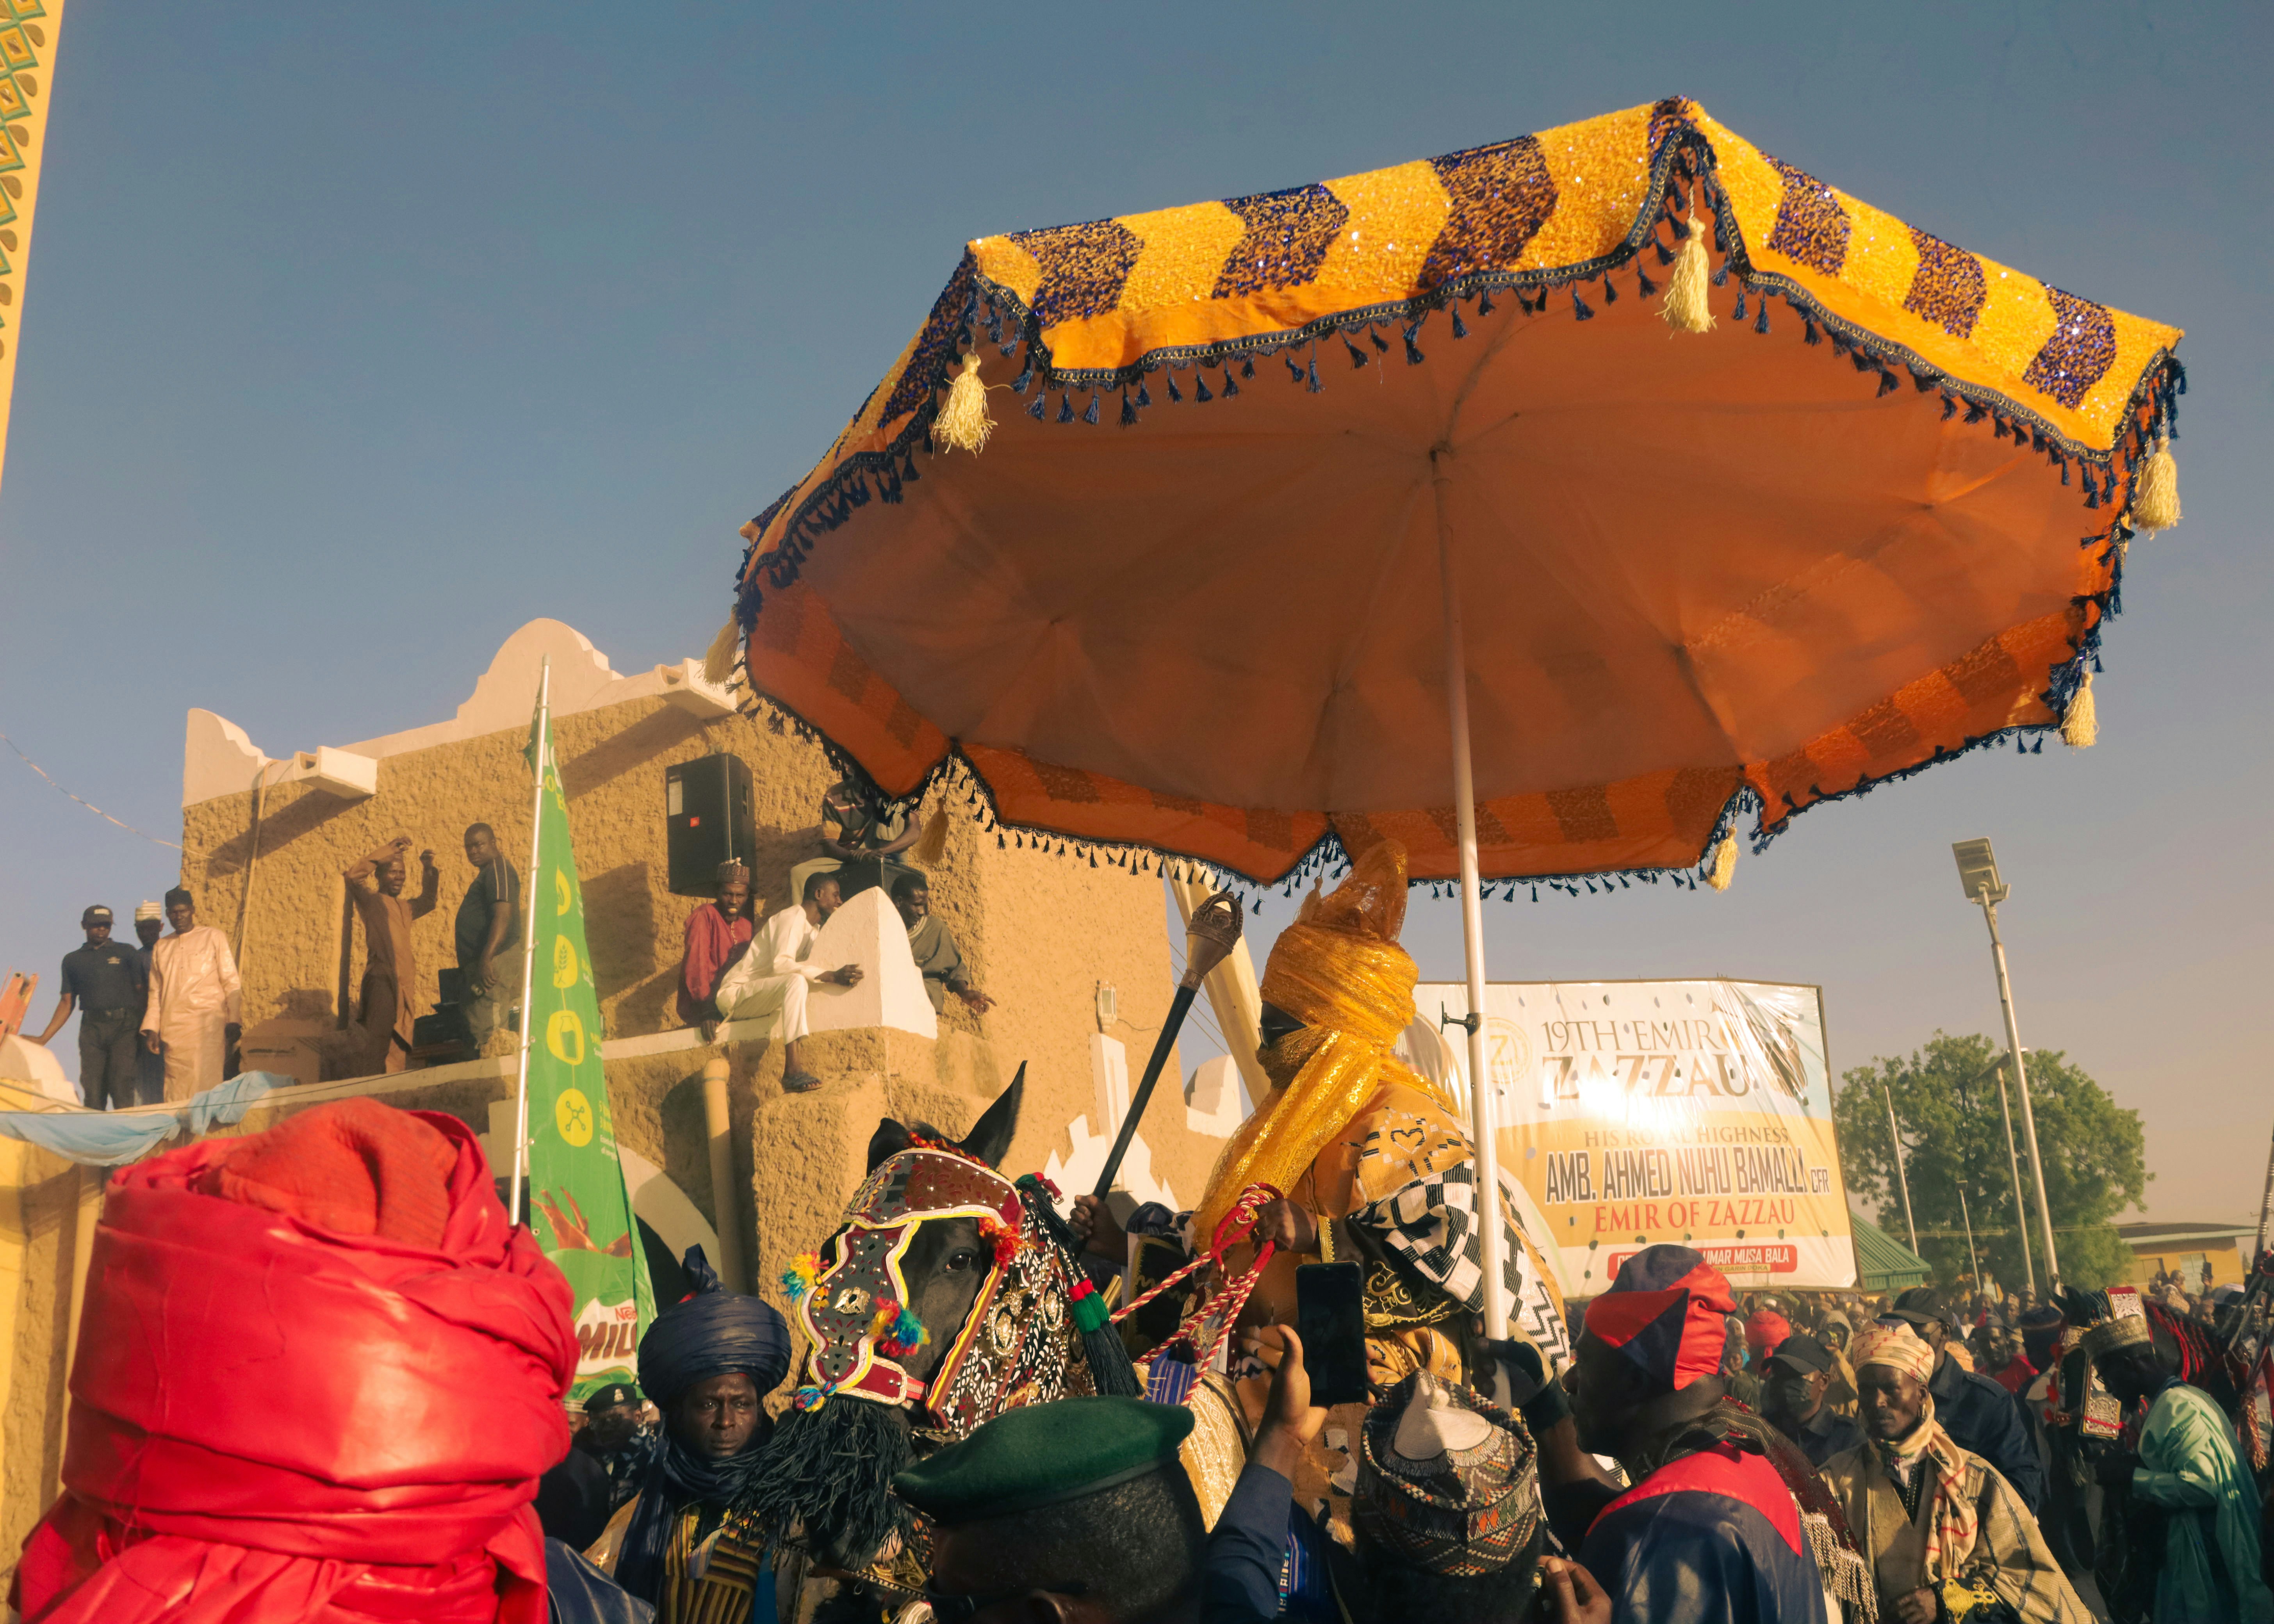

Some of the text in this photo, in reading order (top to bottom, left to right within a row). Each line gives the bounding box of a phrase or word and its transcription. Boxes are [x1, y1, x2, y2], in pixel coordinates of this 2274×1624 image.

[1541, 1020, 1624, 1052] 19TH
[1631, 1020, 1723, 1051] EMIR
[1584, 1130, 1620, 1147] HIS
[1697, 1127, 1789, 1143] HIGHNESS
[1546, 1152, 1597, 1203] AMB.
[1603, 1148, 1672, 1200] AHMED
[1675, 1147, 1732, 1195] NUHU
[1810, 1168, 1830, 1193] CFR
[1594, 1198, 1795, 1232] EMIR OF ZAZZAU
[1734, 1248, 1762, 1264] MUSA
[1765, 1247, 1789, 1263] BALA
